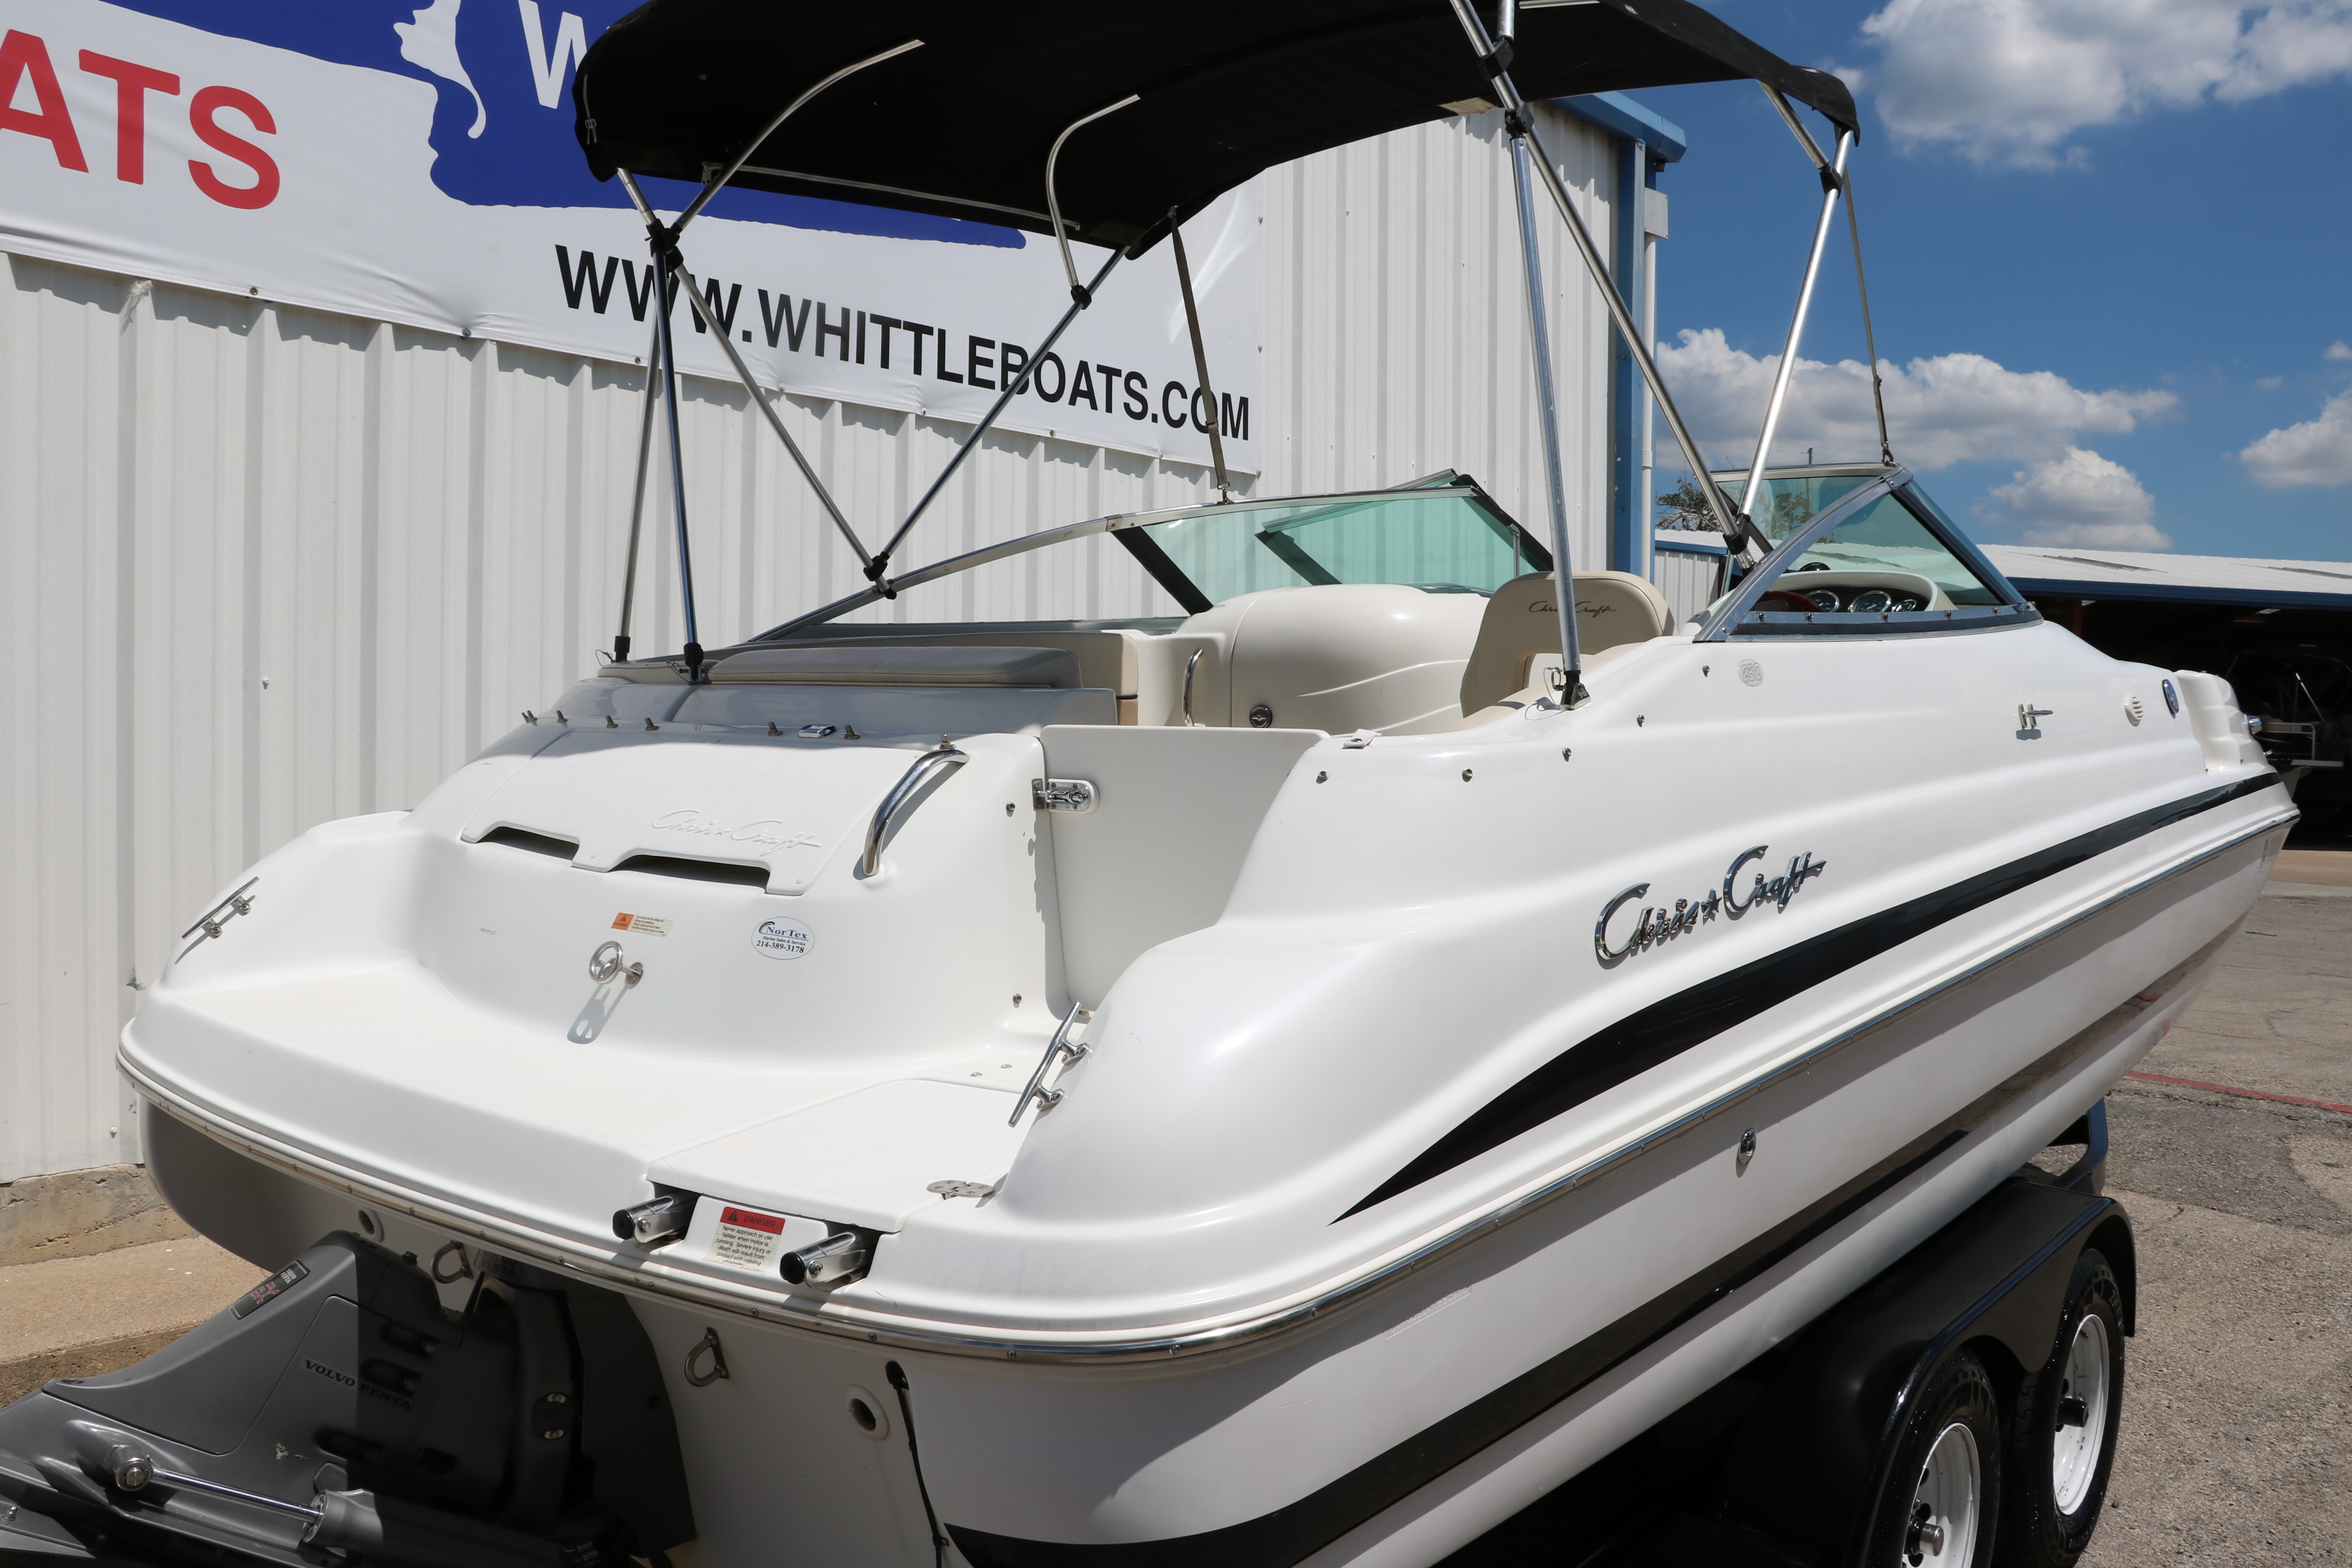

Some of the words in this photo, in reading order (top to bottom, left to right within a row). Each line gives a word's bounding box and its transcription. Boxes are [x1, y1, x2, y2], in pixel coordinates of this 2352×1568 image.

[555, 243, 1250, 441] WWW.WHITTLEBOATS.COM
[1575, 601, 1616, 618] Craft
[1741, 662, 1762, 683] 232
[730, 819, 824, 857] Craft
[1595, 881, 1700, 960] Chris
[1723, 843, 1826, 907] Craft
[766, 926, 808, 939] NorTex
[756, 940, 805, 953] 214-389-3178
[744, 1215, 776, 1227] DANGER
[736, 1227, 757, 1238] approach
[716, 1238, 733, 1247] running.
[736, 1242, 752, 1250] Severe
[752, 1246, 765, 1254] injury
[481, 1257, 517, 1279] PENTA
[305, 1359, 356, 1387] VOLVO
[359, 1382, 411, 1411] PENTA
